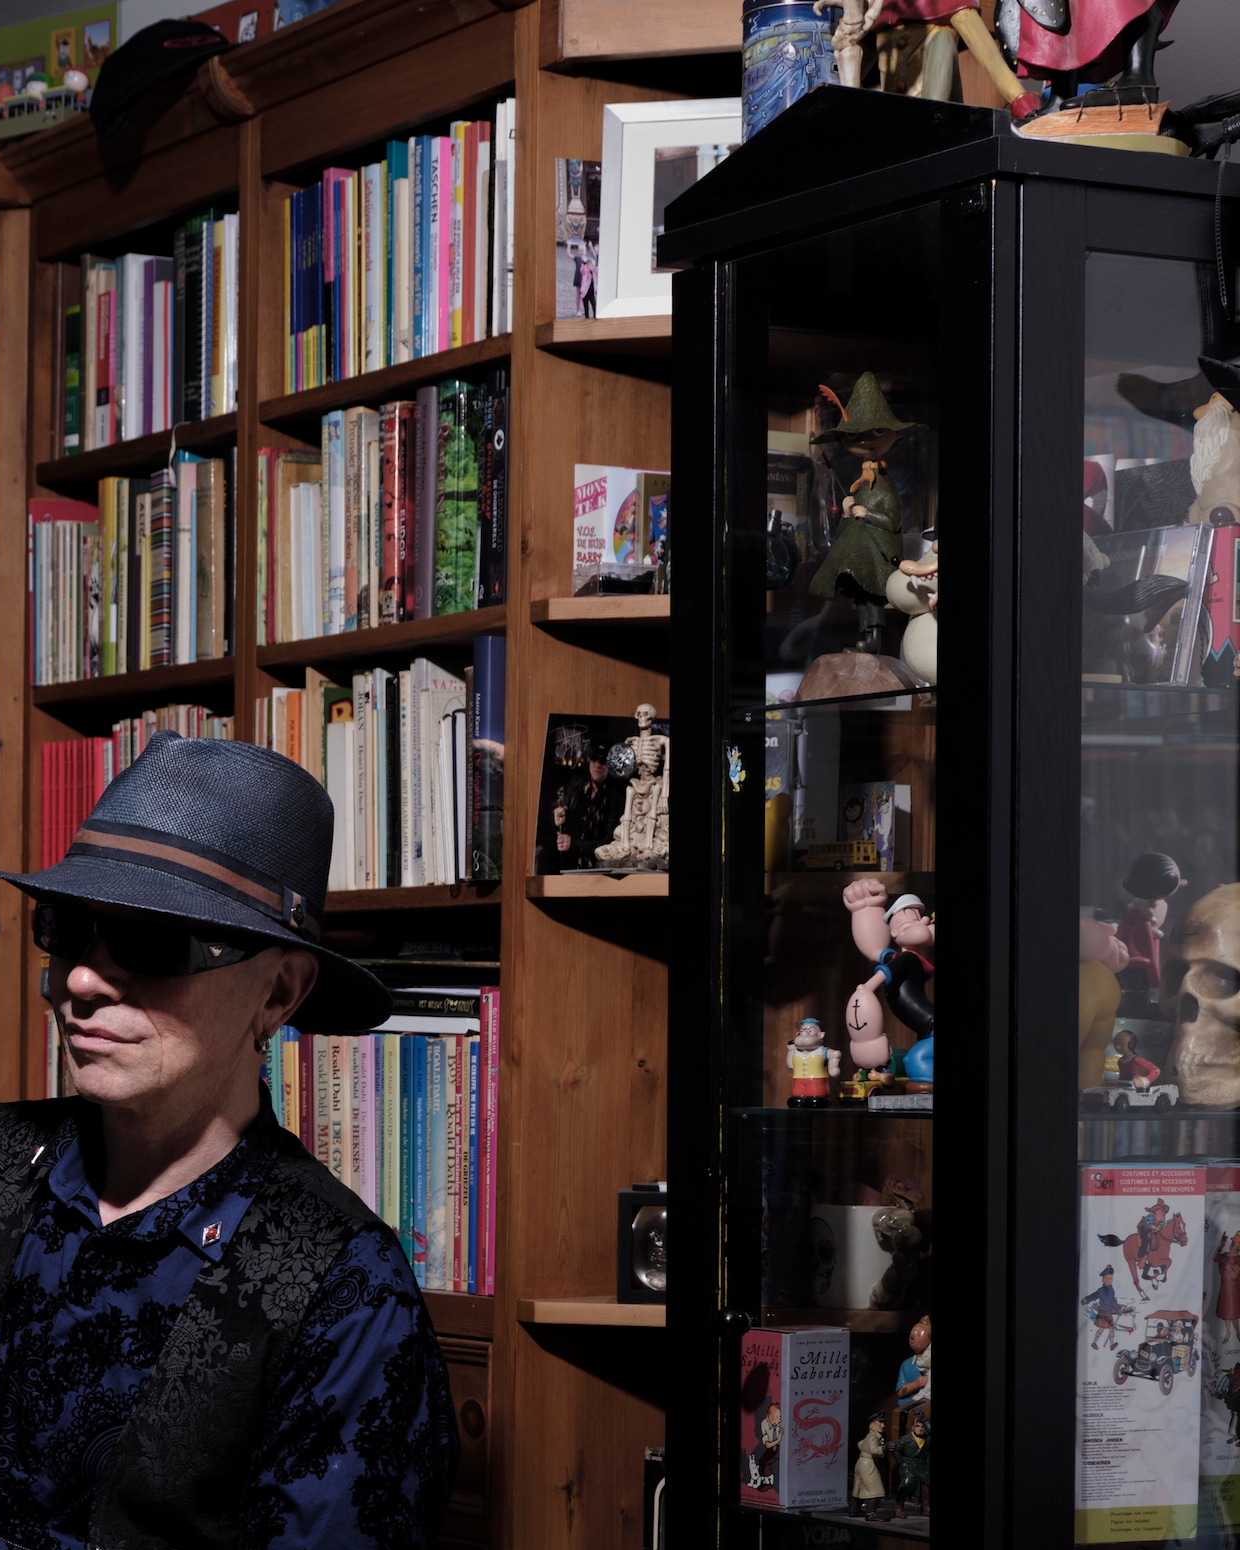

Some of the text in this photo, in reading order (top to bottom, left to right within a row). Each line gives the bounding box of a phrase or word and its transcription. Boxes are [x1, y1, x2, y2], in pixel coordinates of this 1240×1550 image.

[349, 420, 358, 468] Preussler
[576, 551, 603, 562] BARRY
[470, 1055, 477, 1063] DE
[318, 1049, 328, 1118] Roald Dahl
[433, 1045, 441, 1115] ROALD DAHL
[332, 1045, 341, 1145] Roald Dahl DE
[470, 1094, 477, 1102] DE
[352, 1107, 359, 1122] DE
[454, 1113, 461, 1124] en
[416, 1123, 423, 1135] en
[447, 1055, 457, 1197] Boy Roald Dahl
[470, 1119, 477, 1127] EN
[454, 1125, 461, 1136] de
[470, 1128, 477, 1136] IK
[416, 1136, 423, 1147] de
[463, 1151, 468, 1162] DE
[799, 1351, 849, 1365] Mille
[791, 1365, 848, 1380] Sabords
[801, 1525, 851, 1546] YODA
